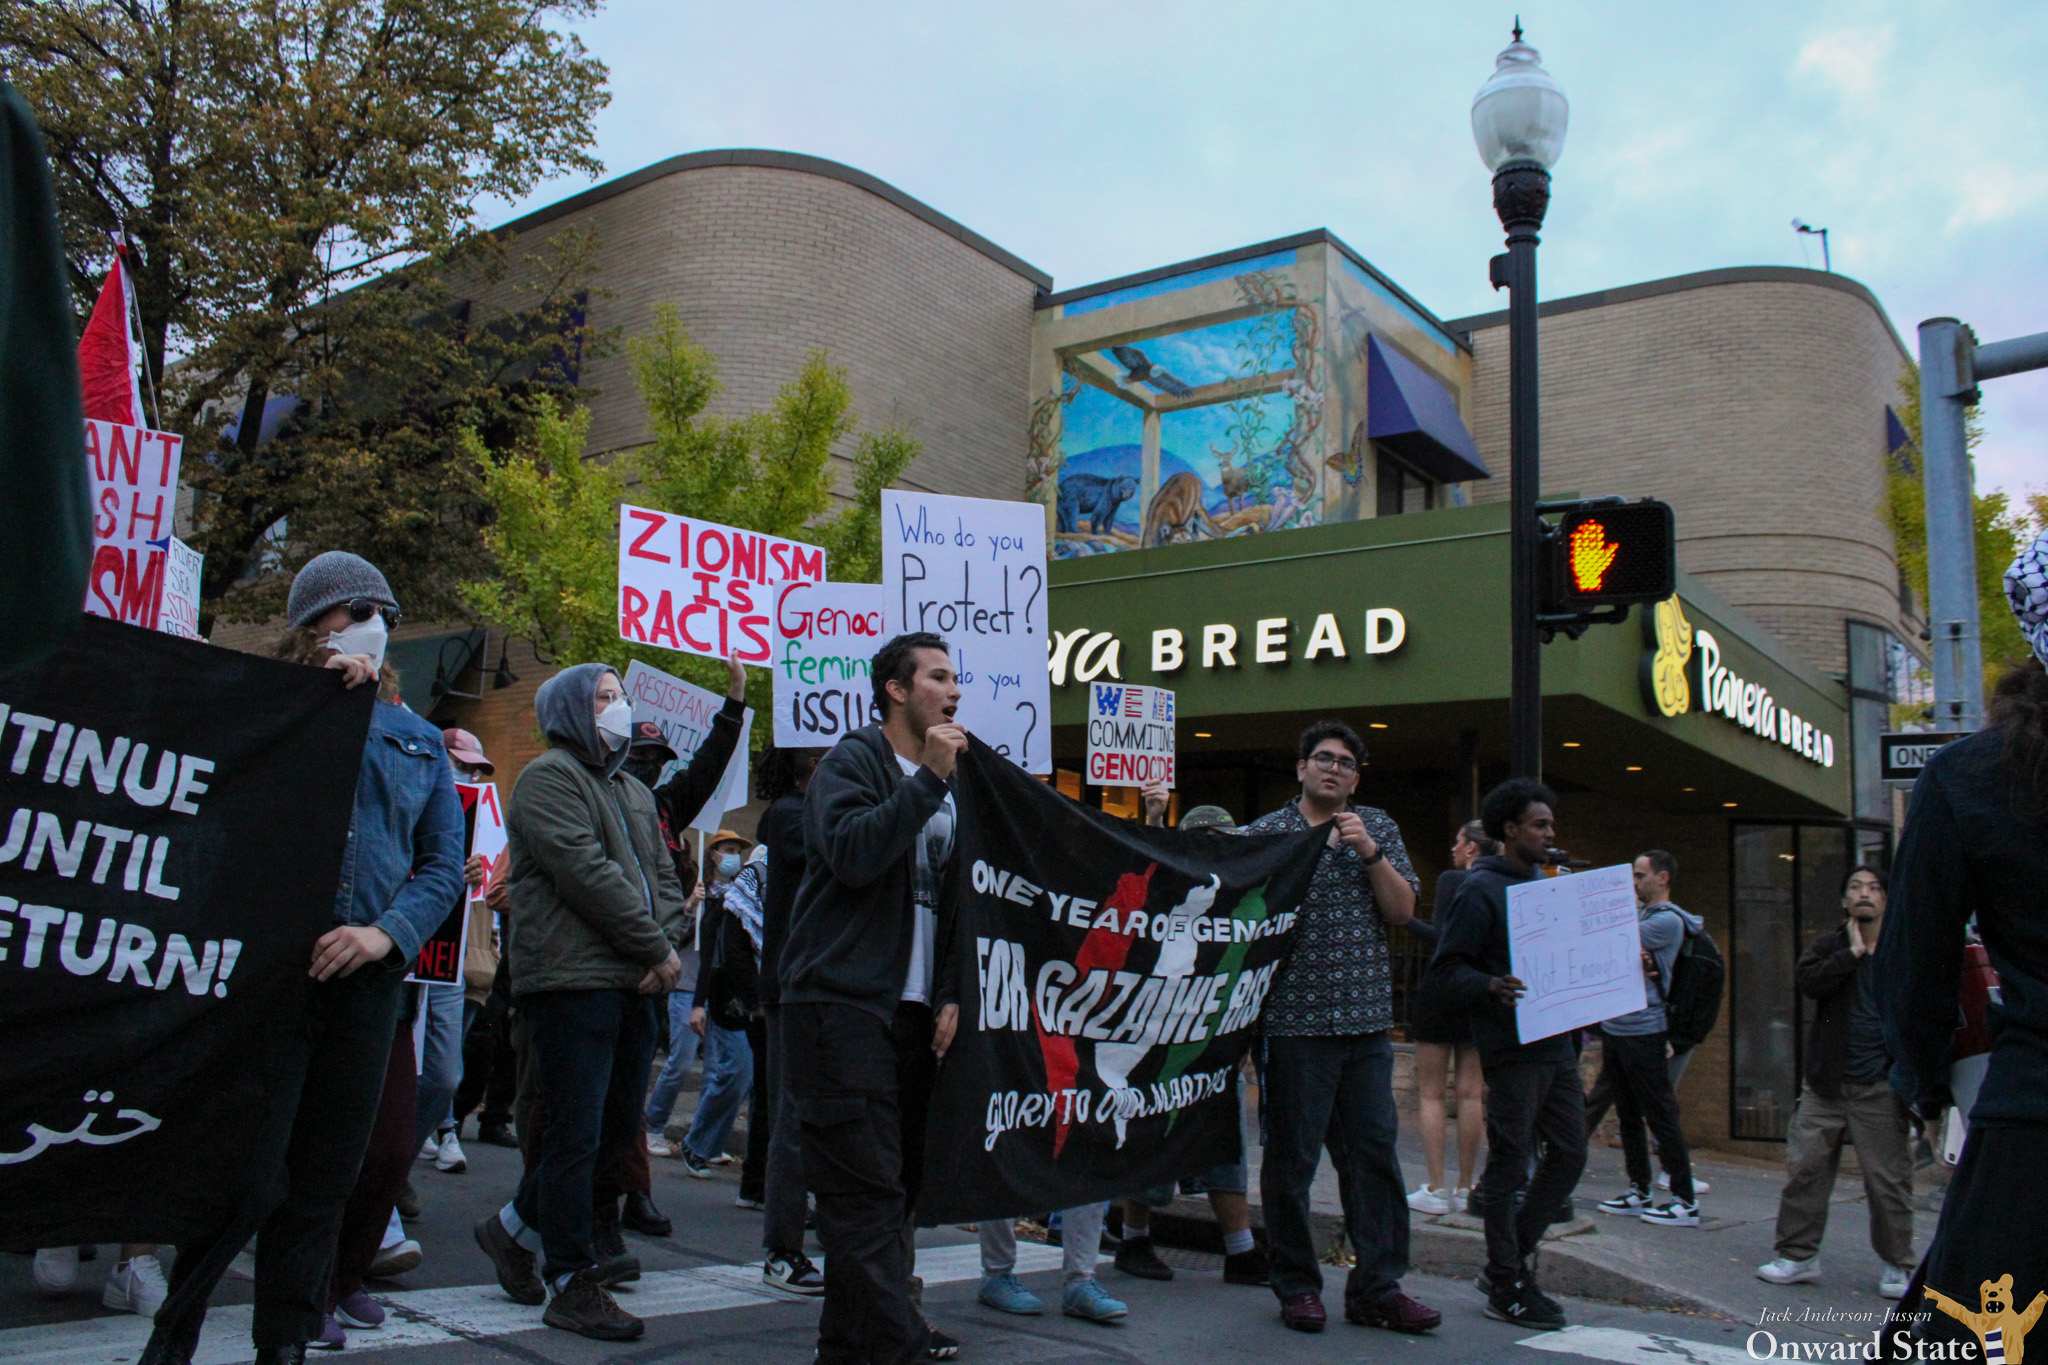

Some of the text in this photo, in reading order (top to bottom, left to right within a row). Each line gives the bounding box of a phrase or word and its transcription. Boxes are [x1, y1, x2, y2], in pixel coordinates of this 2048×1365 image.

[628, 509, 823, 586] ZIONISM
[896, 503, 1024, 561] Who do you
[621, 585, 773, 663] RACIS
[692, 571, 754, 614] IS
[901, 552, 1042, 635] Protect?
[956, 648, 1021, 701] do you
[1047, 607, 1407, 687] ra BREAD
[632, 671, 719, 730] RESISTANC
[1095, 685, 1143, 718] WE
[1695, 629, 1834, 768] Panera BREAD
[1090, 752, 1174, 783] GENOCDE
[972, 859, 1044, 908] ONE
[1046, 890, 1147, 940] YEAR
[1151, 913, 1190, 943] OF
[976, 936, 1030, 1032] FOR
[1521, 951, 1558, 997] Not
[984, 1088, 1057, 1152] GLORY
[1061, 1088, 1092, 1125] TO
